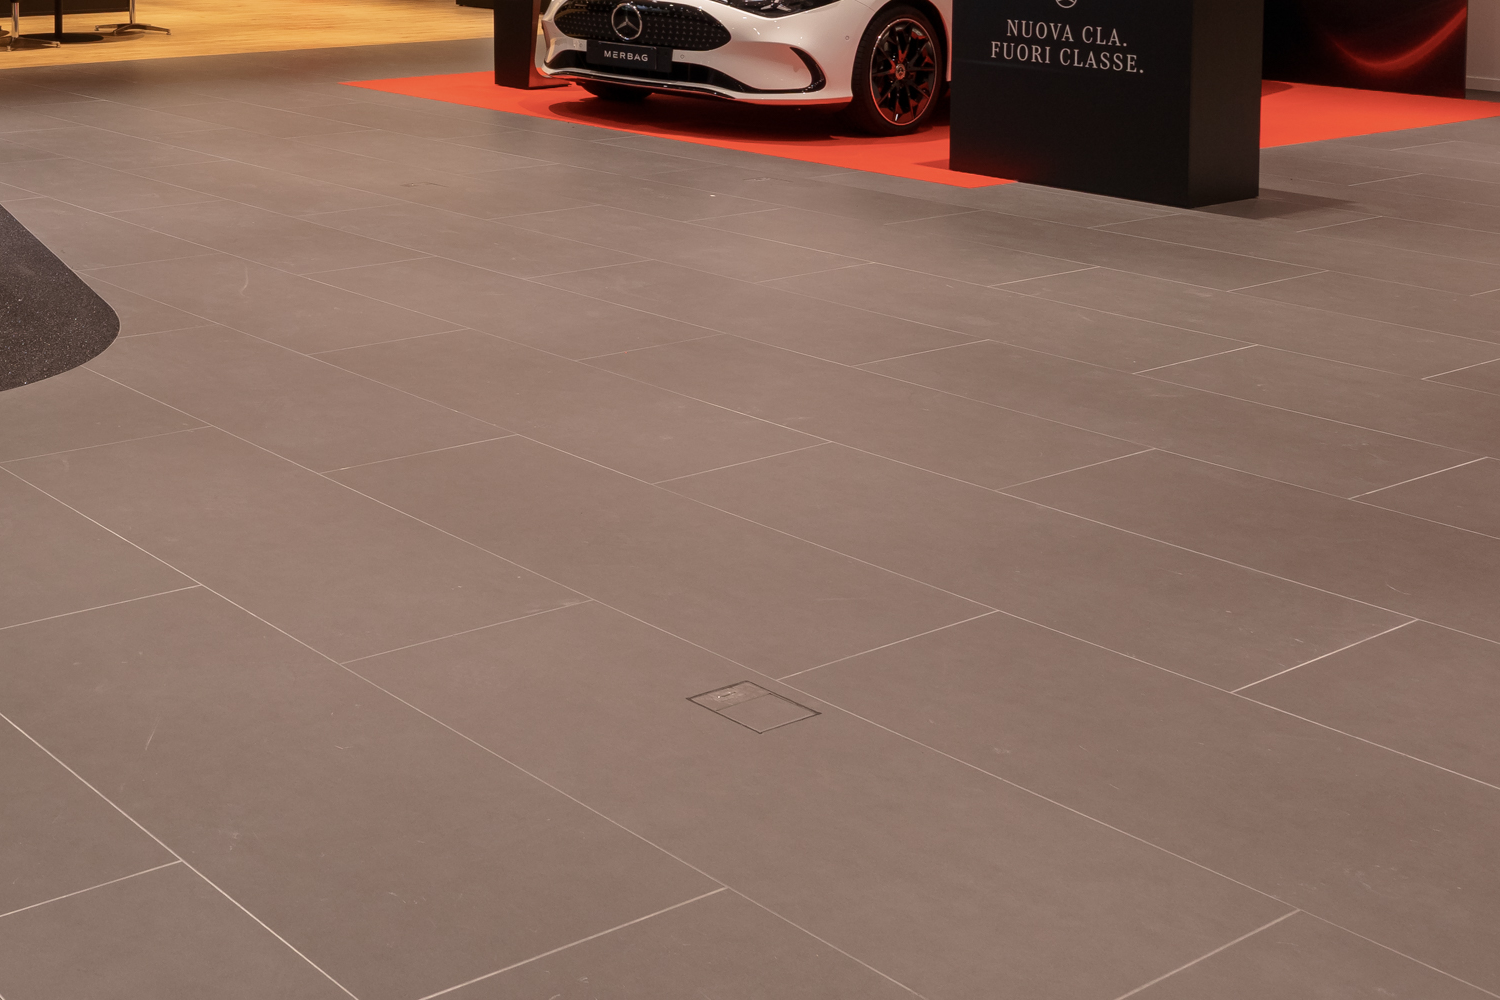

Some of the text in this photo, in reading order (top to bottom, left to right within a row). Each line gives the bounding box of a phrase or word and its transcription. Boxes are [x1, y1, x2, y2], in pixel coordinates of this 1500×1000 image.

[1006, 19, 1127, 47] NUOVA CLA.
[603, 50, 648, 62] MERBAG
[991, 41, 1144, 73] FUORI CLASSE.
